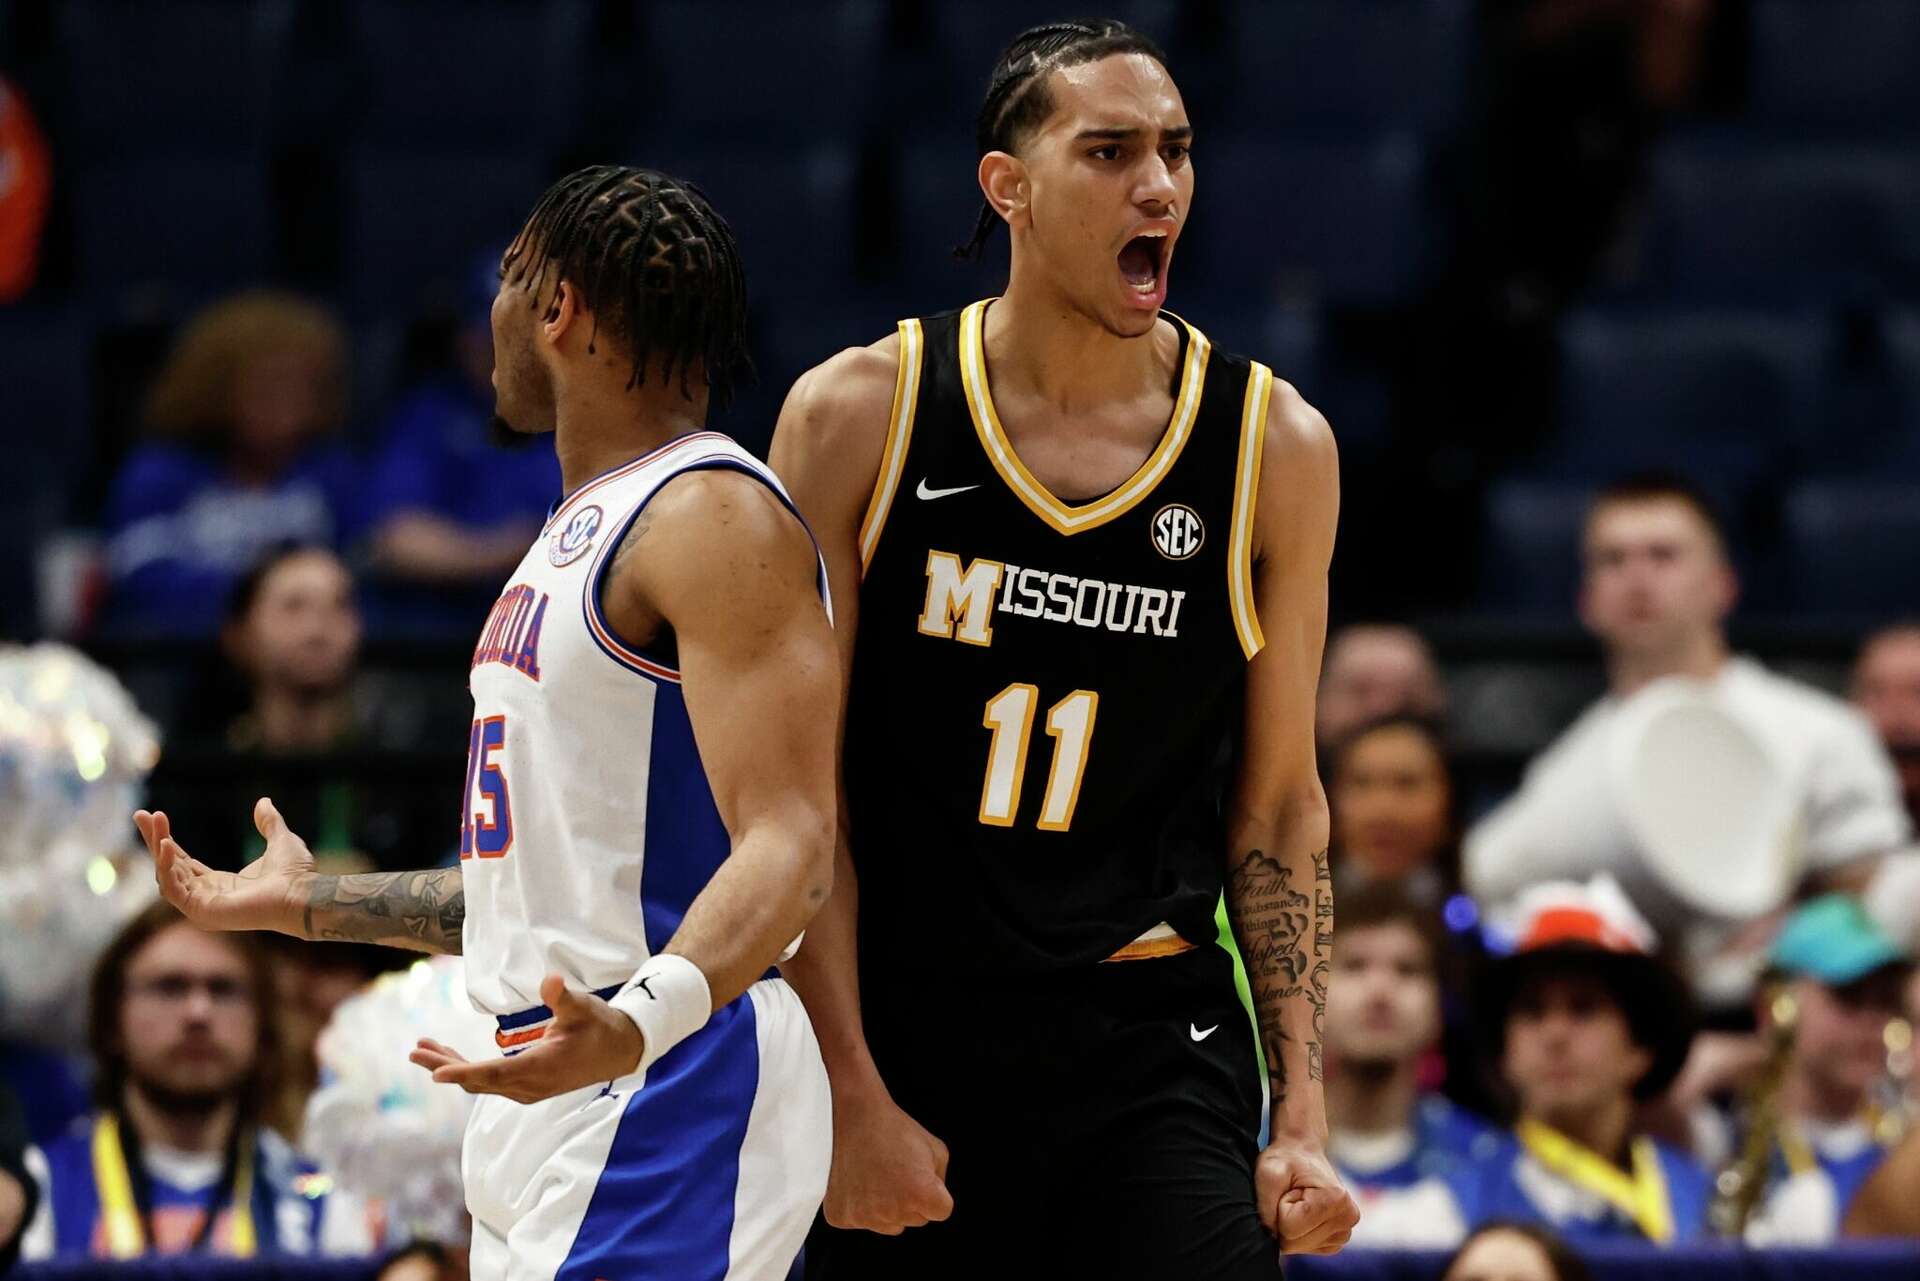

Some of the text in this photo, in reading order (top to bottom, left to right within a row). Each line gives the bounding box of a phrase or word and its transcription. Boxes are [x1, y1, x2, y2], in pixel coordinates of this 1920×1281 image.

[1155, 507, 1202, 556] SEC
[917, 549, 1185, 647] MISSOURI
[978, 682, 1099, 832] 11
